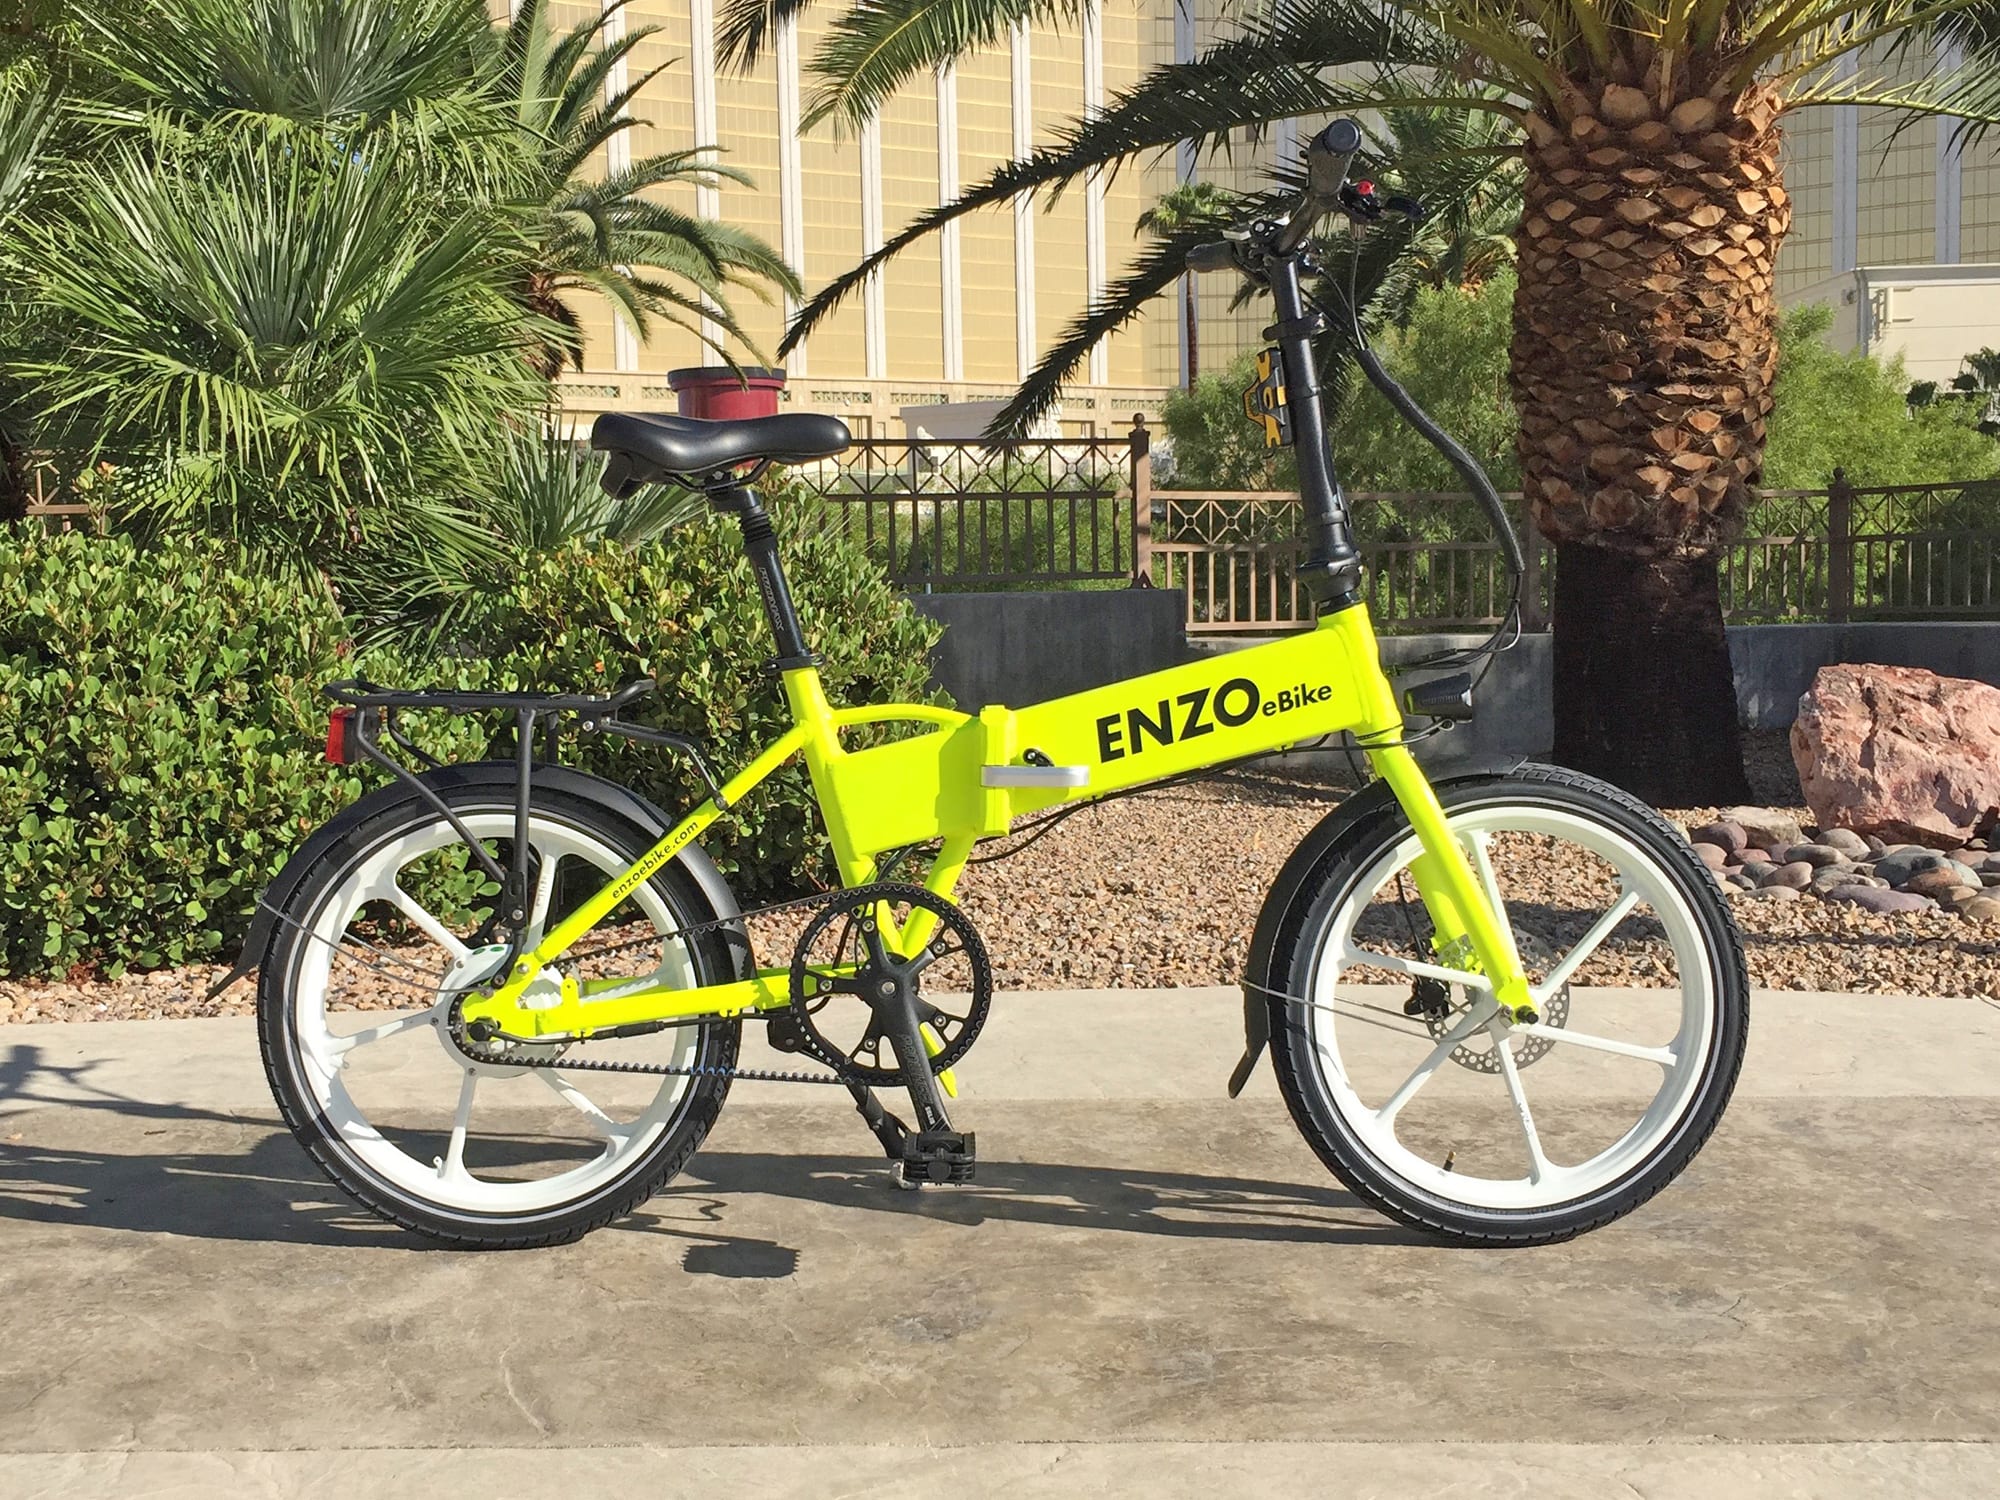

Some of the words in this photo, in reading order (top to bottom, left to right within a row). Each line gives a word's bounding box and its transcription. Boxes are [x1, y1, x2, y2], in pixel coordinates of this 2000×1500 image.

[1096, 677, 1260, 763] ENZO
[1262, 683, 1333, 717] eBike
[611, 820, 699, 899] enzoebike.com
